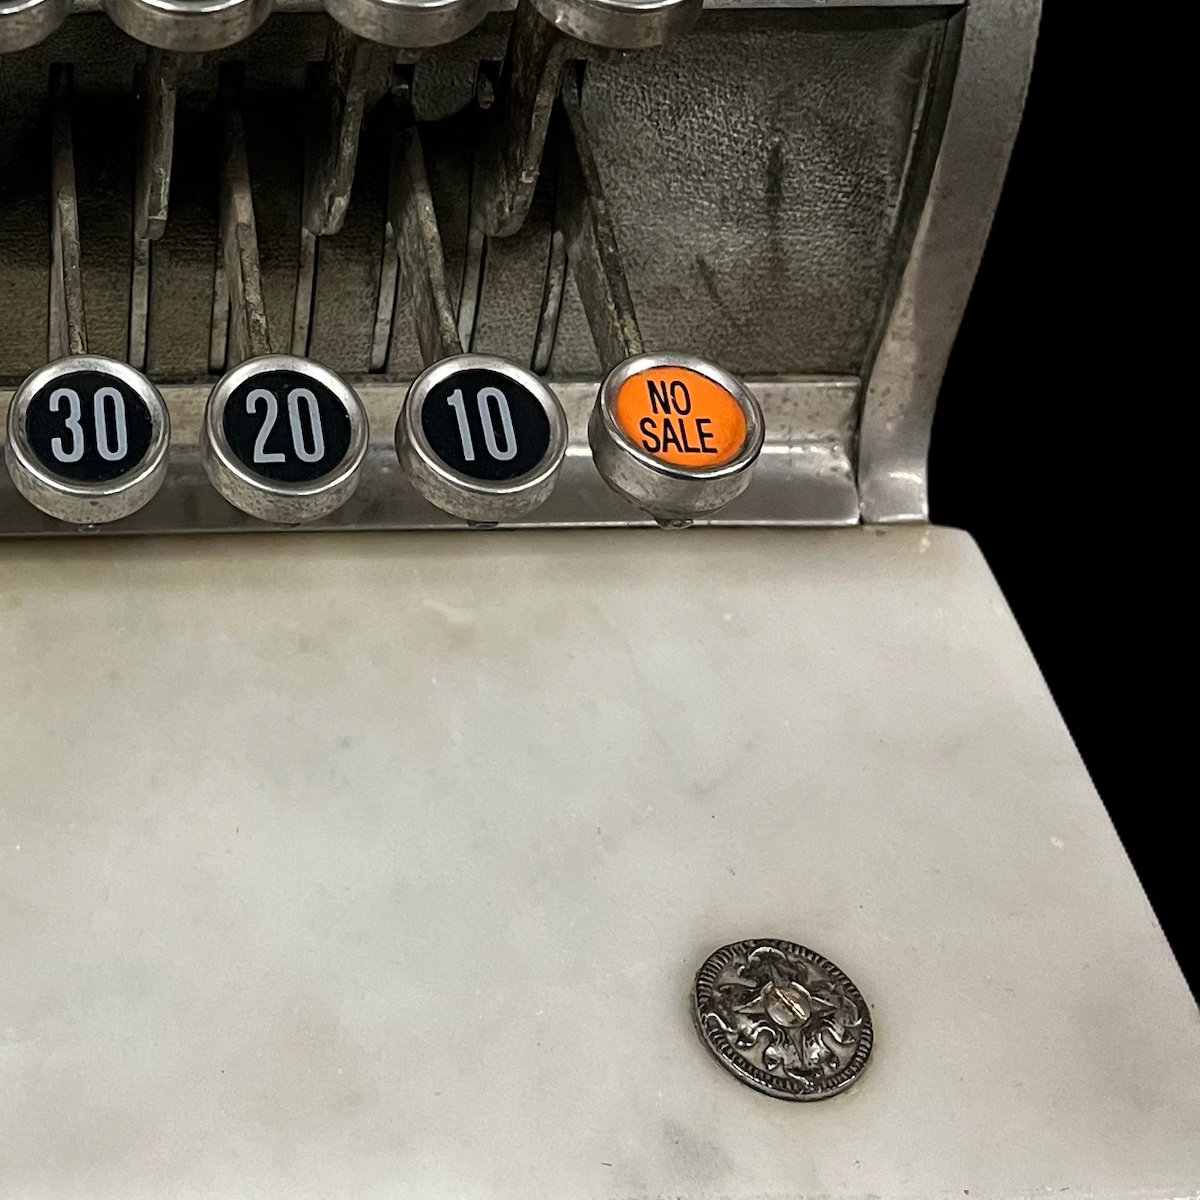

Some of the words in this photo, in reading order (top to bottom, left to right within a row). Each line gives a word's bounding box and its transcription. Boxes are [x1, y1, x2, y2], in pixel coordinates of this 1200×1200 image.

[50, 387, 127, 462] 30
[246, 388, 324, 463] 20
[447, 387, 517, 460] 10
[647, 379, 692, 415] NO
[640, 416, 718, 454] SALE
